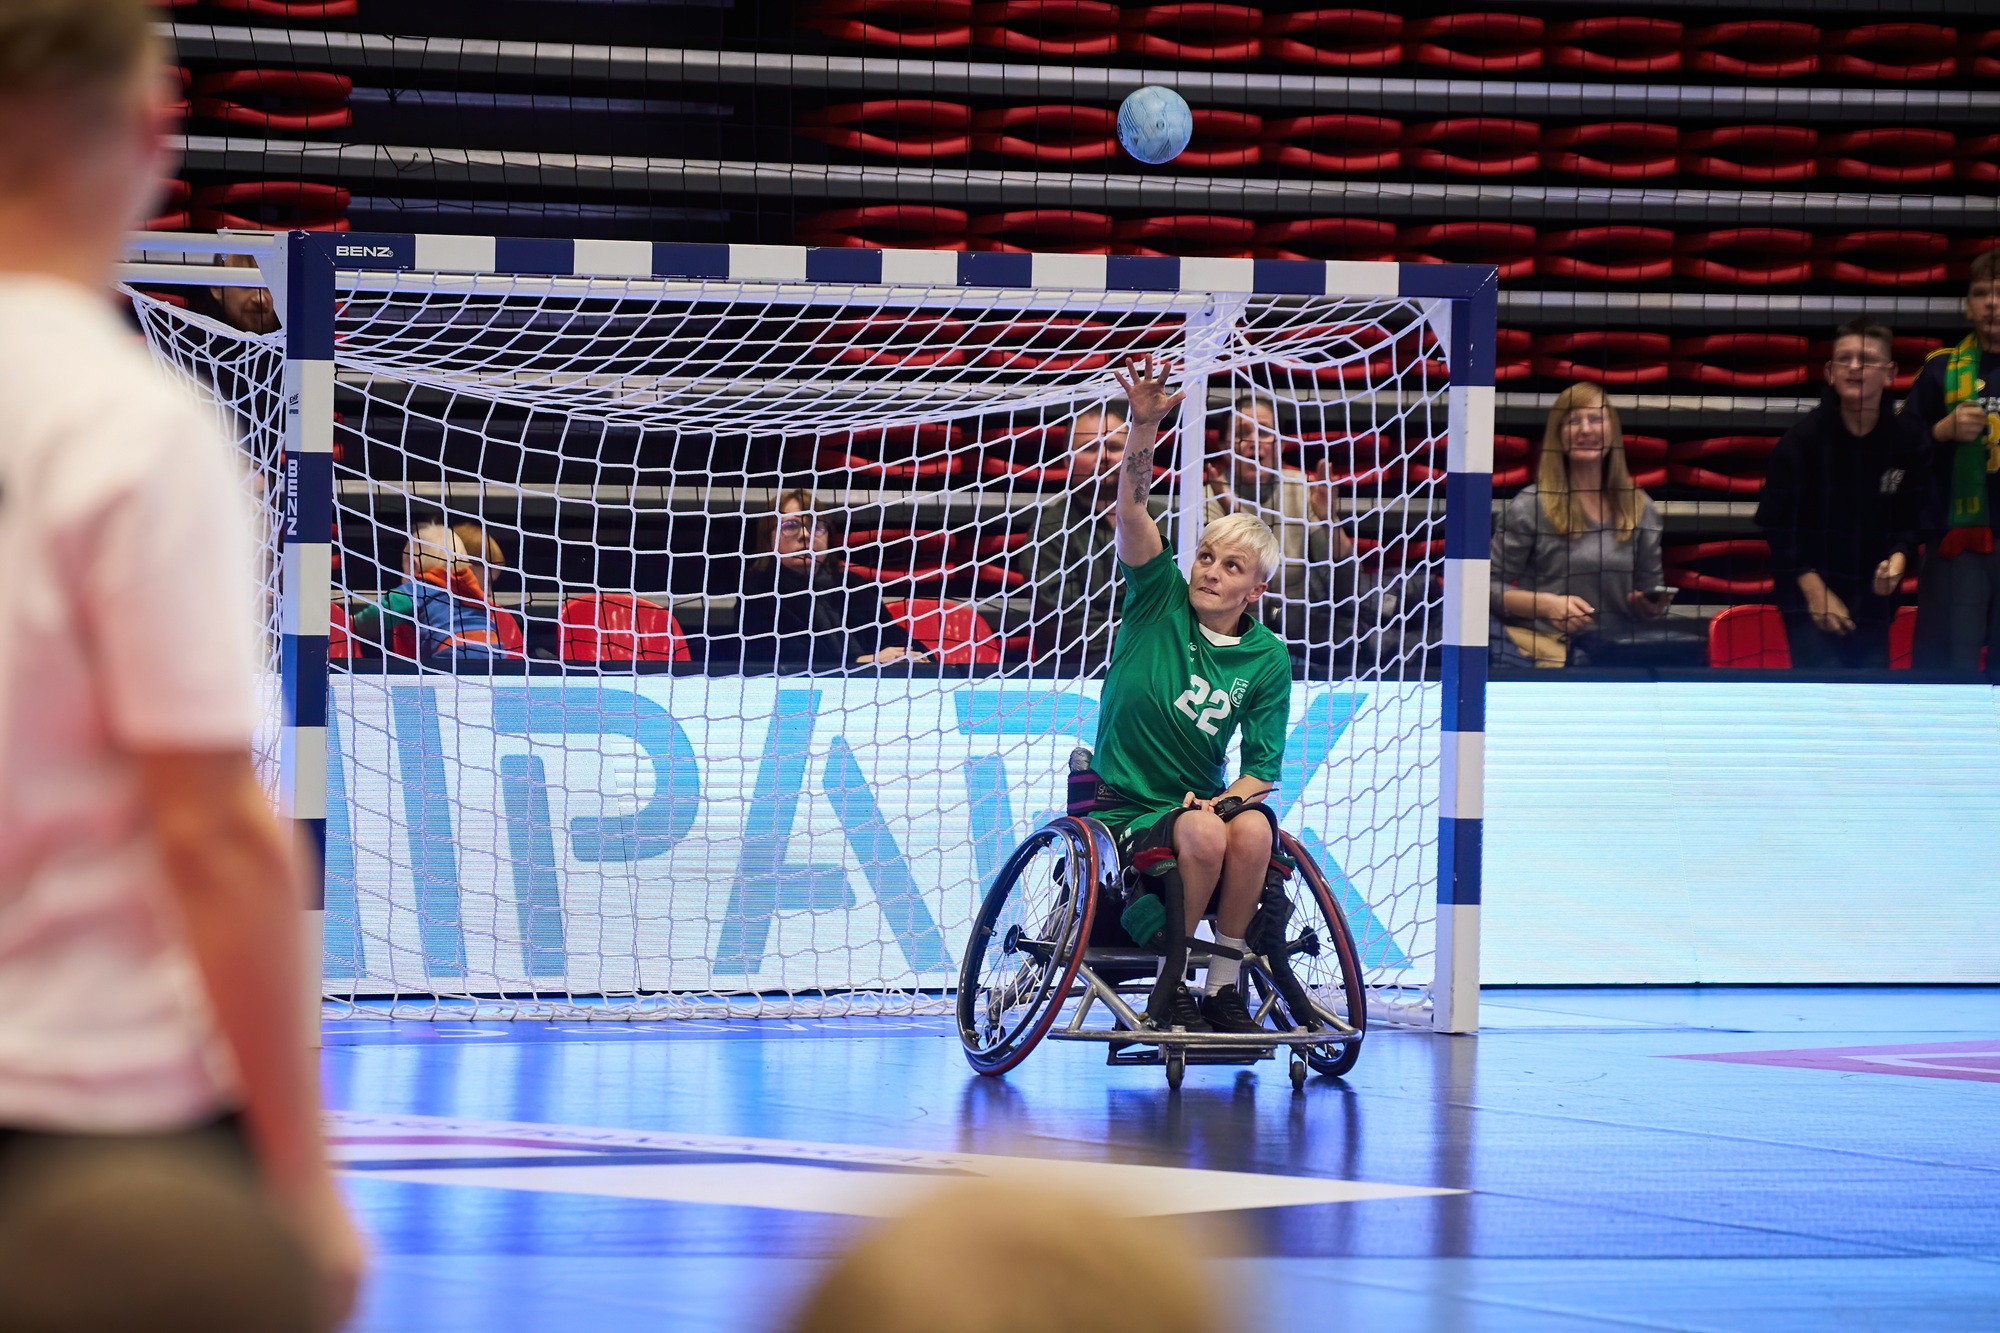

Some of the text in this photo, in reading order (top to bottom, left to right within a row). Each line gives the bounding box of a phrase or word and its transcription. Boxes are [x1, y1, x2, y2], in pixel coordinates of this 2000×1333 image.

[336, 245, 391, 257] BENZ
[286, 458, 299, 536] BENZ
[1174, 674, 1231, 737] 22
